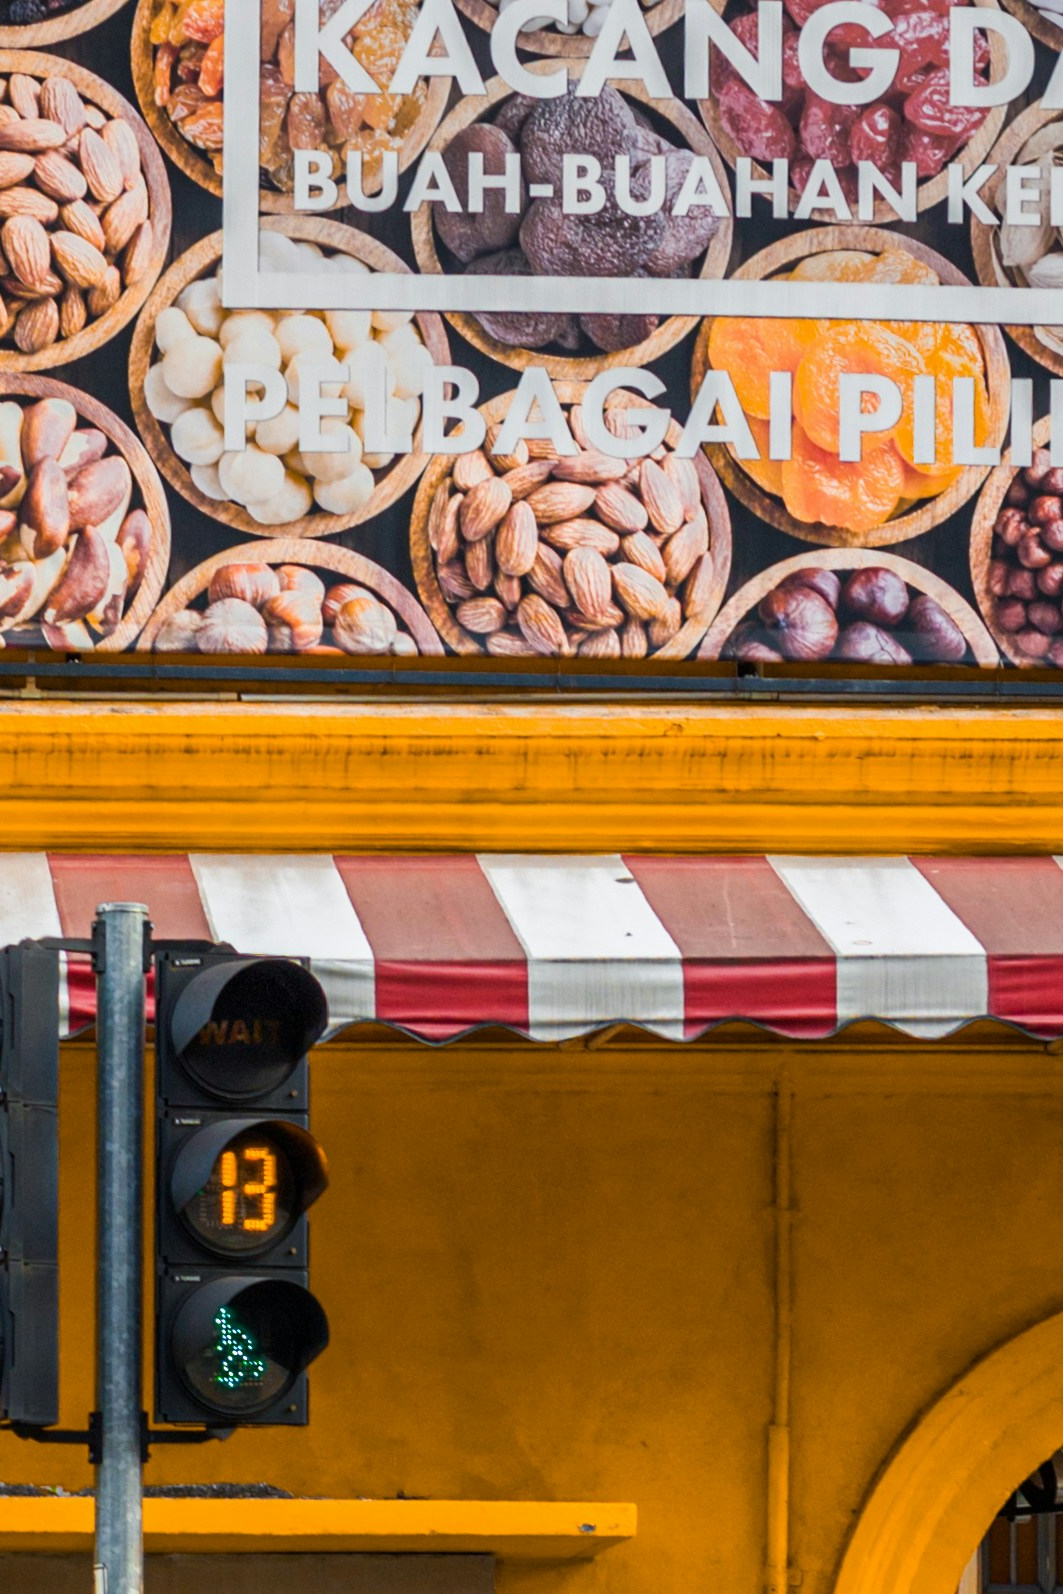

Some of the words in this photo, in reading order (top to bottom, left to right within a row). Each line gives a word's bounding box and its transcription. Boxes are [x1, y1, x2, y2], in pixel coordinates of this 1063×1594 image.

[294, 0, 900, 106] KACANG
[949, 6, 1063, 110] D
[294, 149, 918, 223] BUAH-BUAHAN
[948, 163, 1063, 227] KE
[223, 363, 792, 460] PELBAGAI
[838, 372, 1063, 468] PILI
[199, 1018, 281, 1047] WAIT
[221, 1147, 277, 1232] 13
